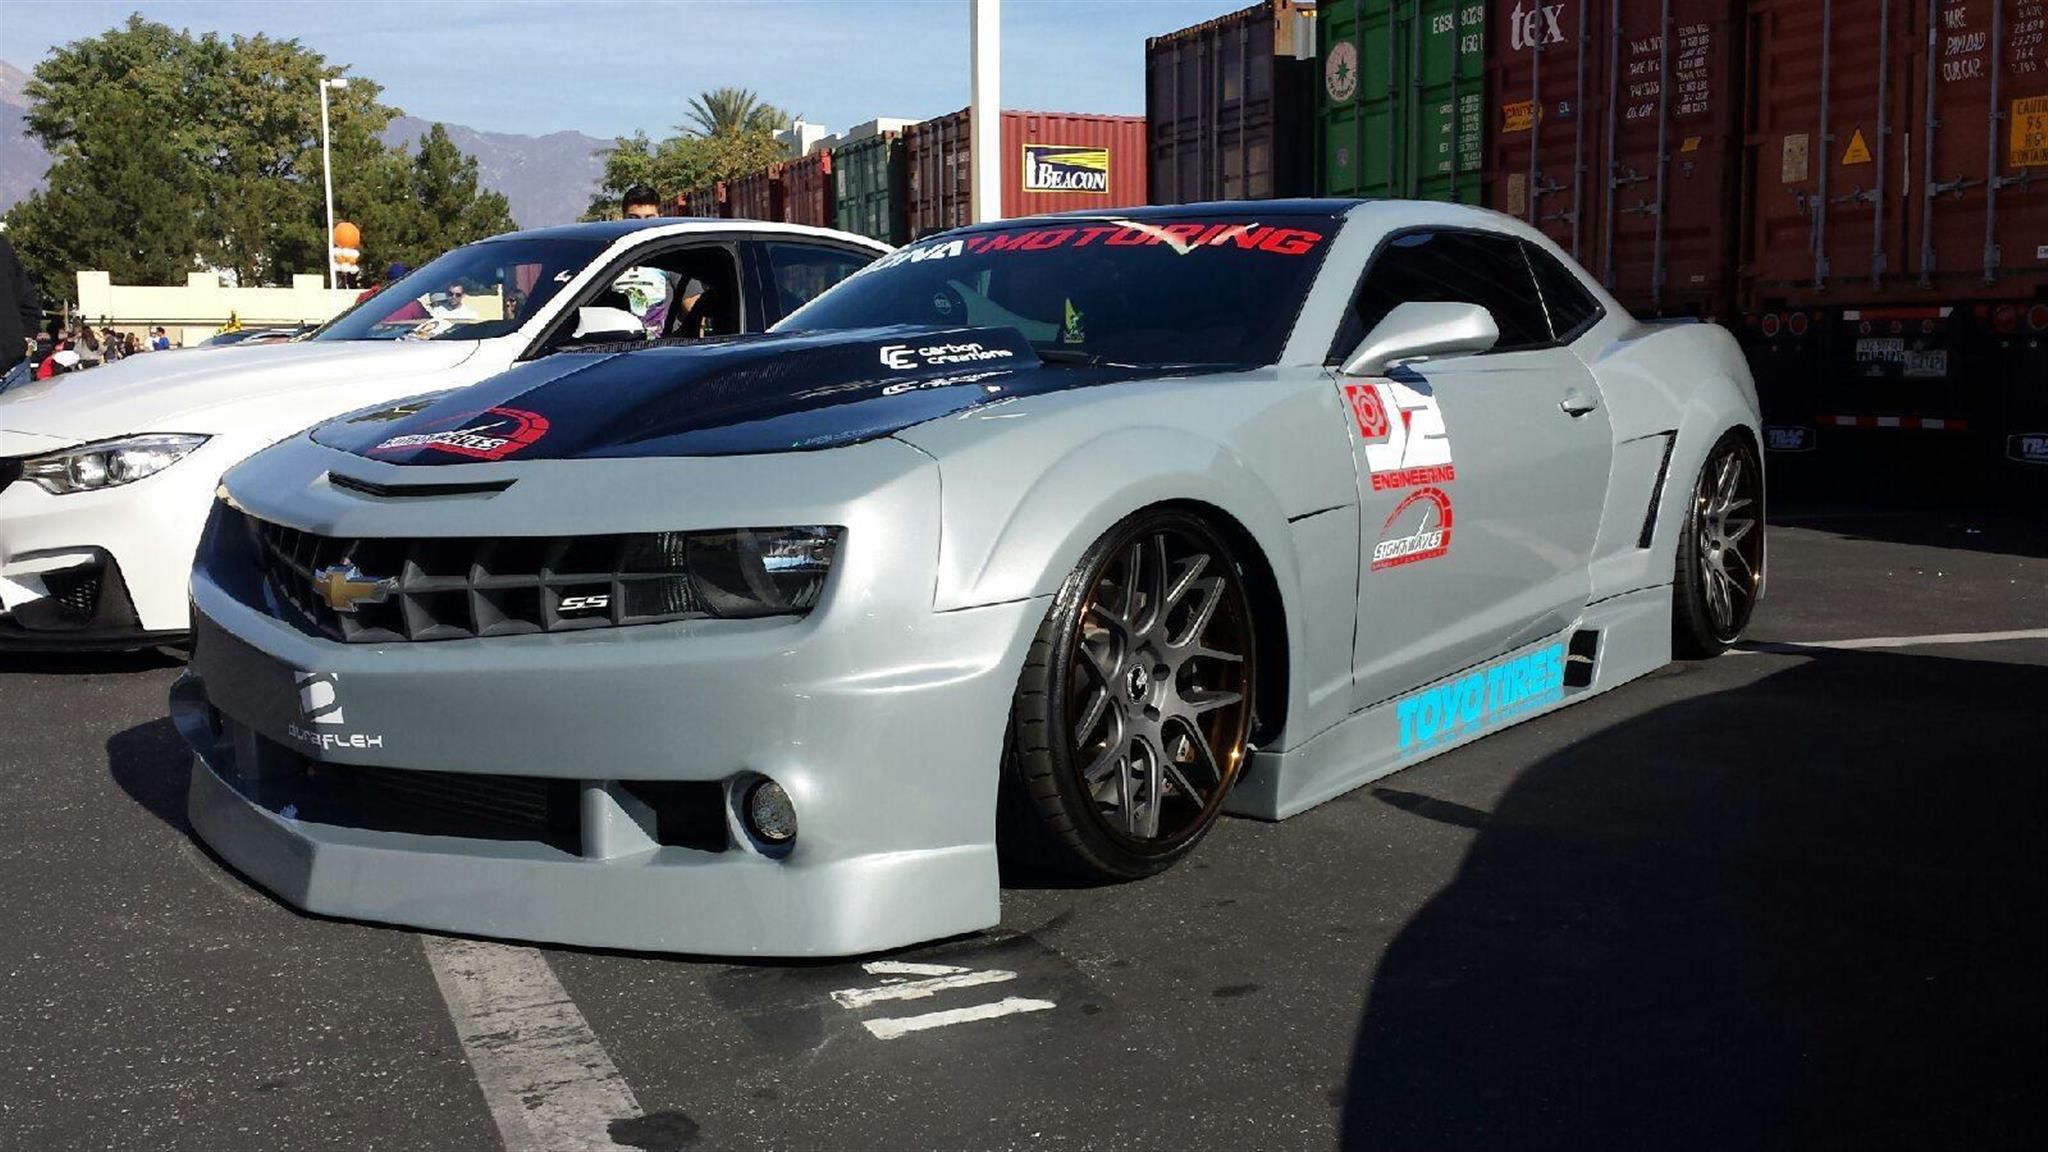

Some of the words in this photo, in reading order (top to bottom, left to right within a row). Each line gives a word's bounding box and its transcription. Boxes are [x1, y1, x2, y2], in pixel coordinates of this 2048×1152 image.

[1510, 1, 1566, 52] tex
[1943, 7, 1968, 30] TARE
[1944, 31, 1987, 57] PAYLOAD
[1038, 162, 1106, 190] BEACON
[976, 222, 1323, 256] MOTORING
[918, 342, 984, 357] carbon
[926, 349, 1014, 365] creations
[1371, 465, 1455, 492] ENGINEERING
[558, 595, 610, 611] SS
[1397, 672, 1485, 751] TOYO
[1487, 642, 1564, 713] TIRES
